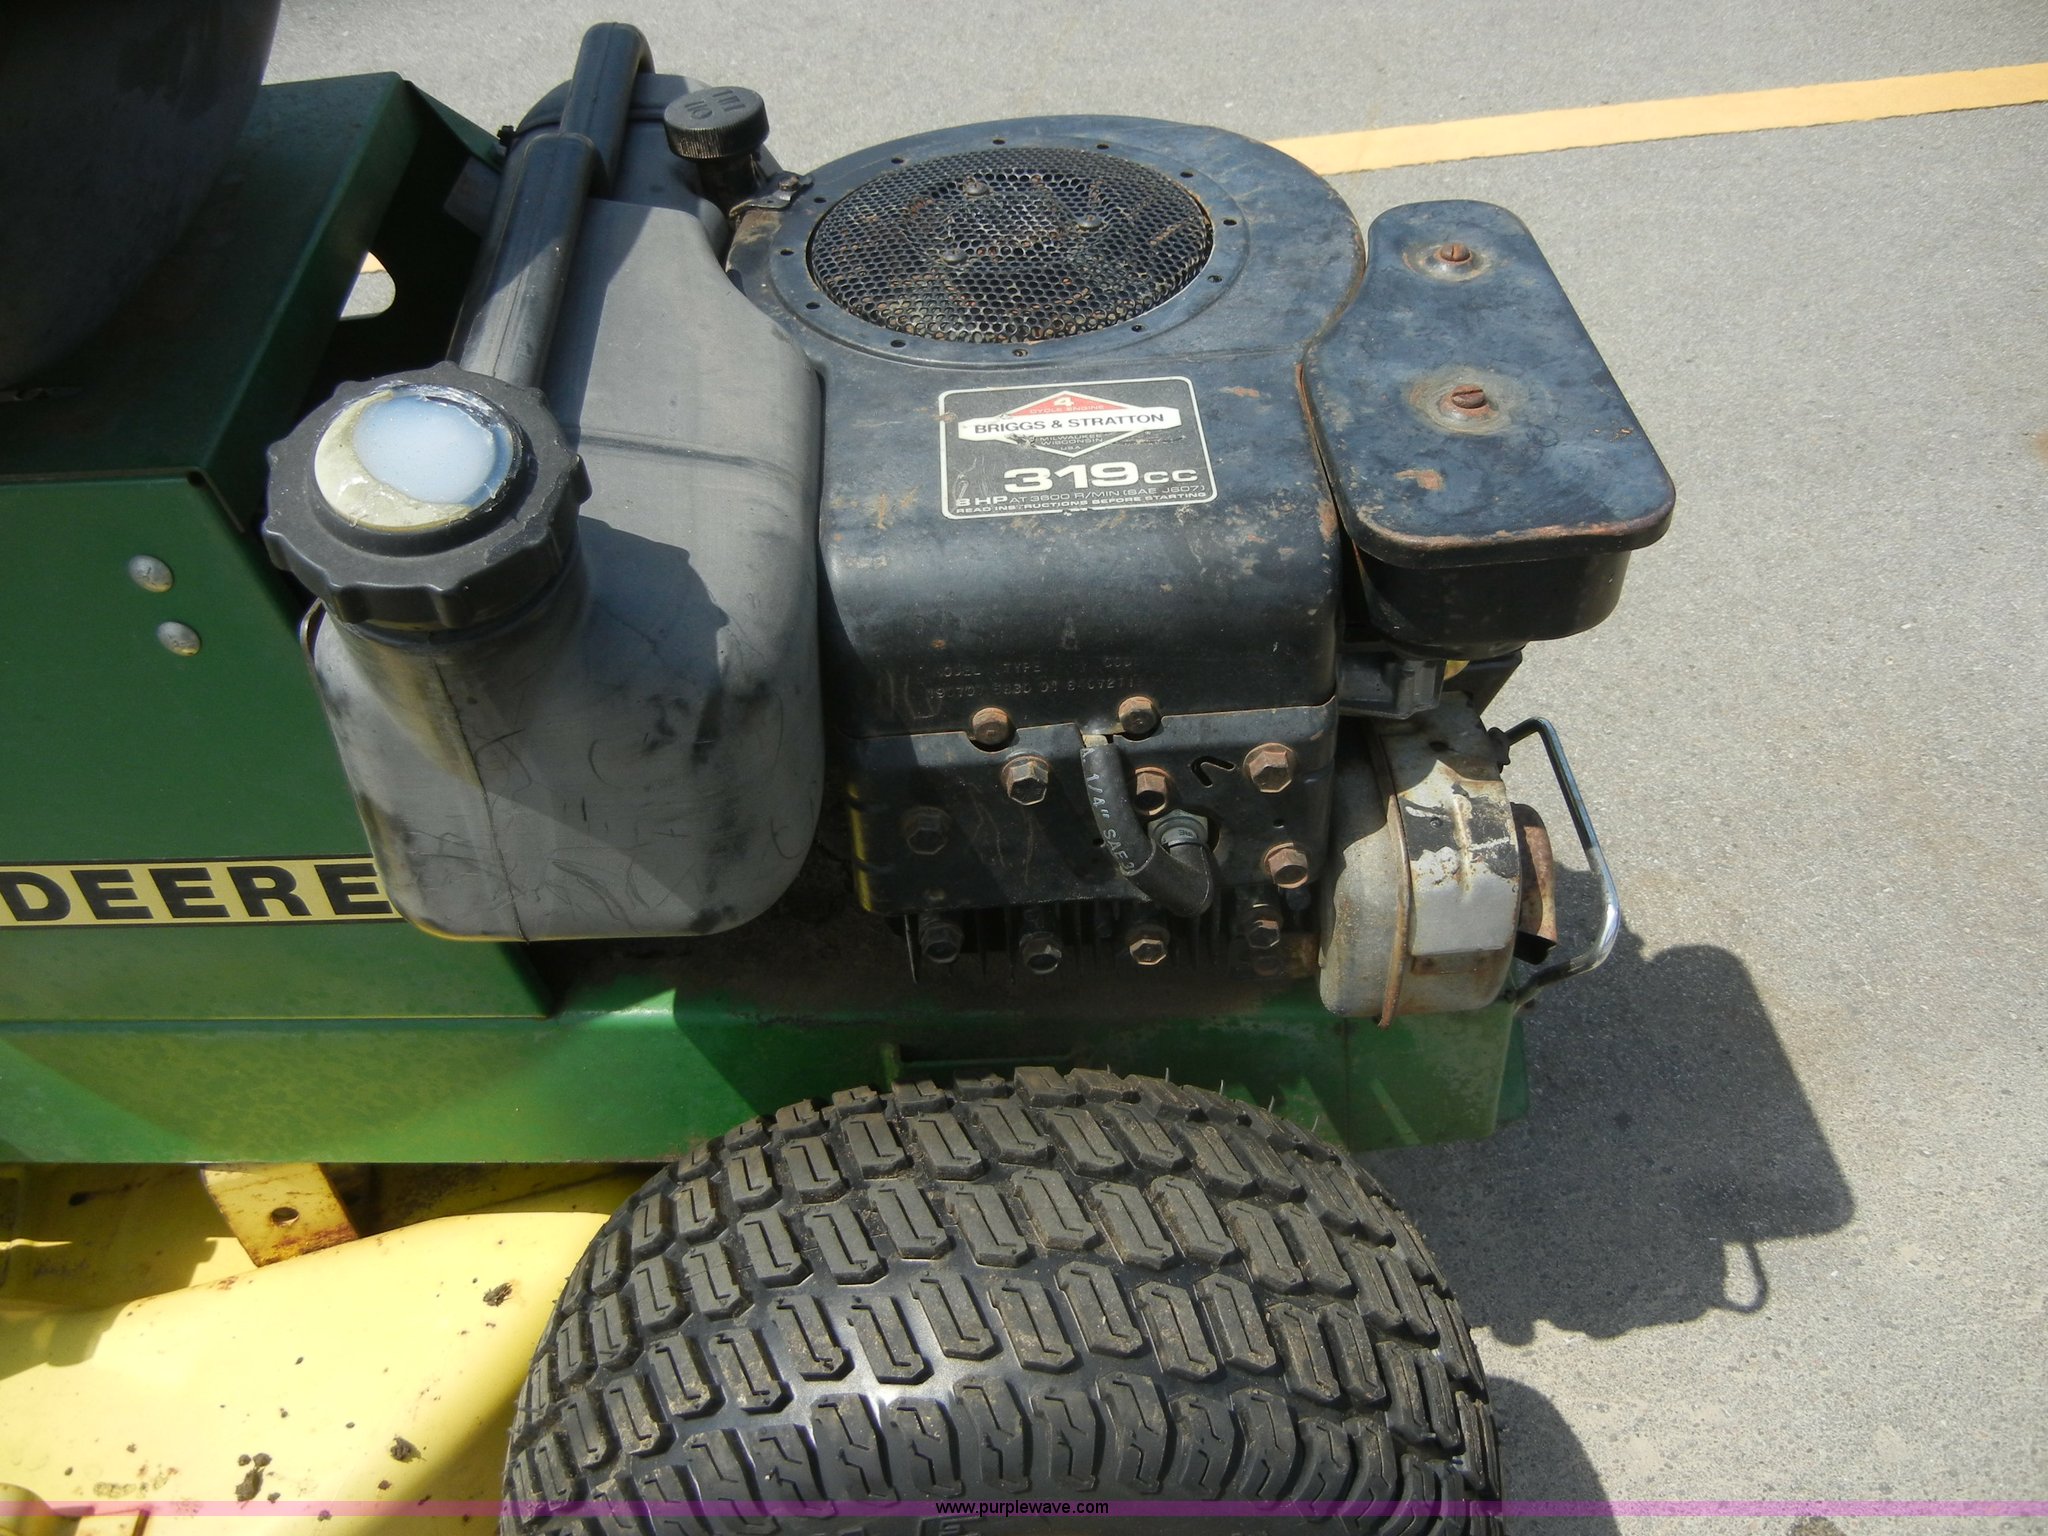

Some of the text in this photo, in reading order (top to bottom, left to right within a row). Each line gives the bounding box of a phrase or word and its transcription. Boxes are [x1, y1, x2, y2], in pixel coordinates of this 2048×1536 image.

[1054, 397, 1074, 407] 4
[1066, 404, 1104, 412] ENGINE
[974, 413, 1164, 434] BRIGGS & STRATTON
[1040, 437, 1104, 446] WISCONSIN
[956, 506, 991, 514] READ
[1091, 496, 1141, 505] BEFORE
[1145, 492, 1206, 501] STARTING
[1009, 496, 1028, 504] AT
[1030, 493, 1071, 502] 3600
[1074, 490, 1120, 499] R/MIN
[1122, 487, 1157, 496] (SAE
[1162, 484, 1205, 494] J607)
[1103, 828, 1129, 862] SAE
[0, 863, 393, 921] DEERE
